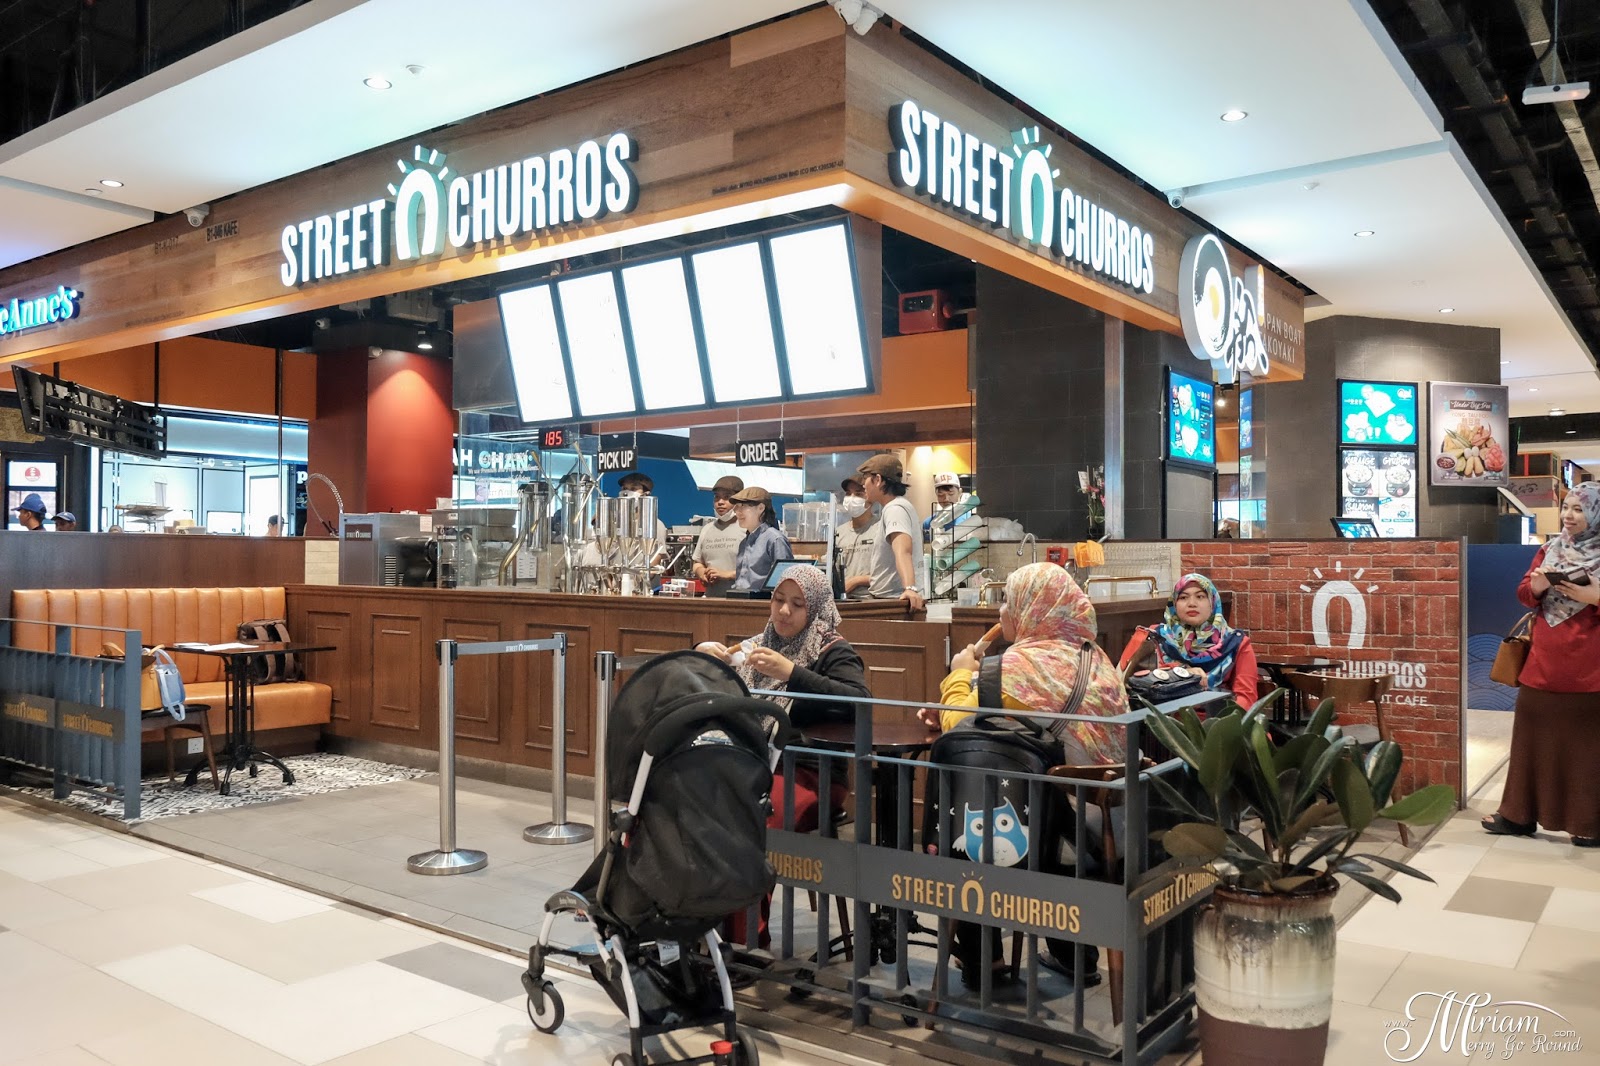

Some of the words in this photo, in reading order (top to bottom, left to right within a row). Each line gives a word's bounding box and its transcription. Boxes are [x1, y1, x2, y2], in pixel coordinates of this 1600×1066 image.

[280, 198, 386, 287] STREET
[449, 132, 632, 248] CHURROS
[899, 99, 1014, 229] STREET
[1060, 187, 1154, 295] CHURROS
[224, 220, 237, 237] KAFE
[1263, 313, 1282, 335] PAN
[1283, 322, 1302, 346] BOAT
[1260, 332, 1295, 364] AKOYAKI
[544, 431, 563, 446] 185
[739, 441, 779, 464] ORDER
[598, 450, 618, 470] PICK
[620, 449, 634, 469] UP
[1395, 694, 1428, 706] CAFE
[766, 850, 823, 884] URROS
[891, 873, 956, 910] STREET
[990, 890, 1081, 934] CHURROS
[1143, 883, 1175, 926] STREET
